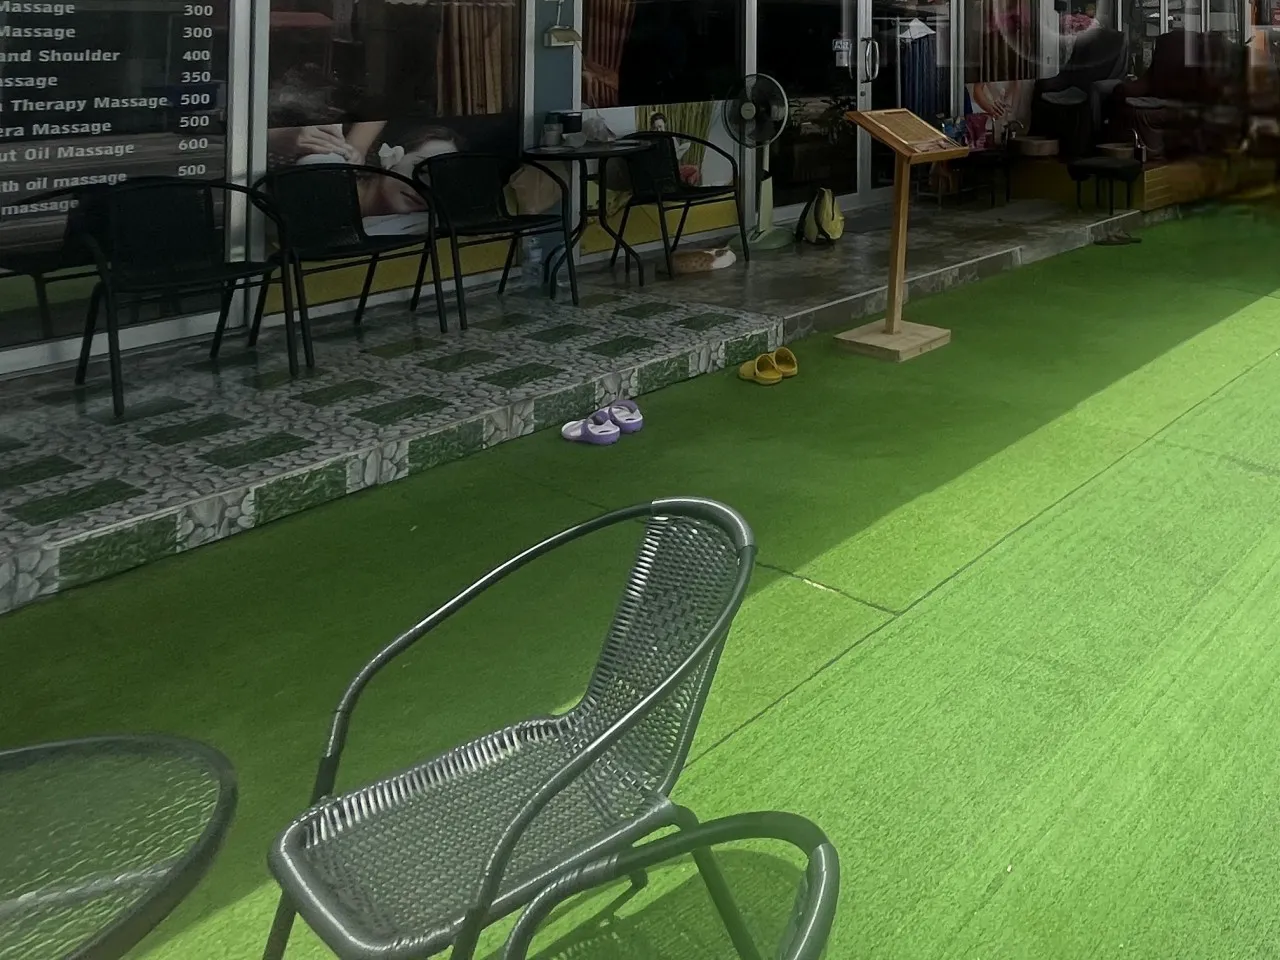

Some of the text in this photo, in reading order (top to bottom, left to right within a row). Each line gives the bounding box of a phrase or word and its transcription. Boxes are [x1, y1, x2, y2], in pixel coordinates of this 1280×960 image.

[183, 5, 213, 16] 300
[183, 27, 212, 38] 300
[38, 49, 120, 62] Shoulder
[182, 50, 210, 61] 400
[181, 71, 211, 83] 350
[11, 93, 210, 112] Therapy Massage 500
[32, 121, 112, 136] Massage
[179, 115, 209, 127] 500
[25, 147, 49, 161] Oil
[57, 143, 135, 159] Massage
[178, 138, 208, 150] 600
[26, 177, 47, 190] oil
[53, 172, 127, 189] massage
[178, 164, 206, 176] 500
[1, 199, 79, 215] massage
